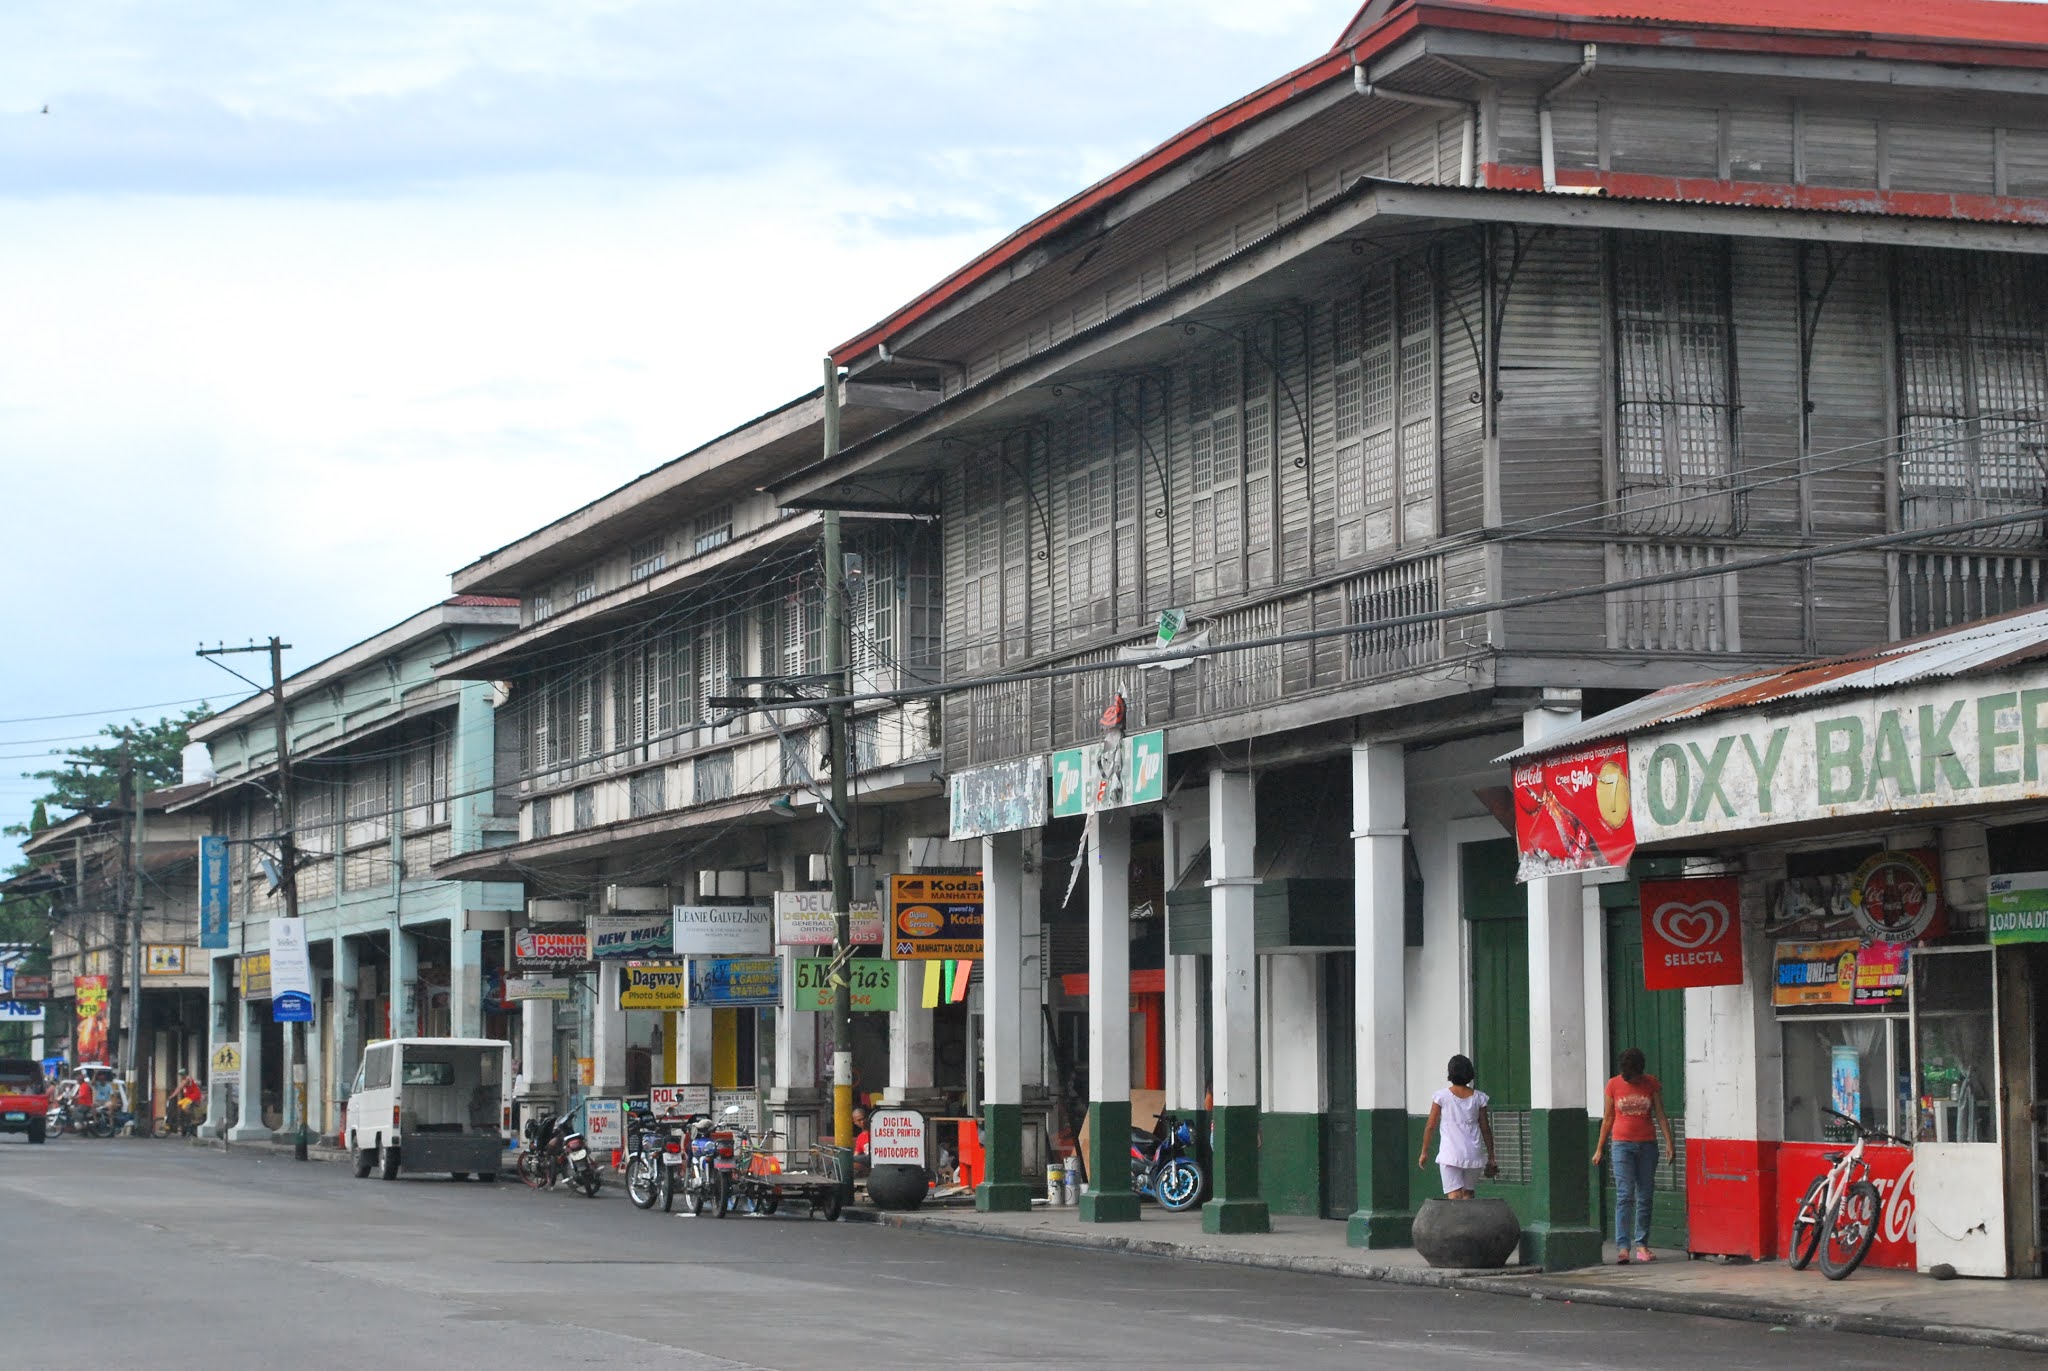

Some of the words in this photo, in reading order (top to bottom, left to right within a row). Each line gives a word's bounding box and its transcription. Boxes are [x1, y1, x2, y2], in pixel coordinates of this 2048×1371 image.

[1647, 726, 1790, 826] OXY
[930, 881, 984, 891] Koda
[800, 895, 817, 911] DE
[677, 908, 707, 923] LEANIE
[709, 908, 768, 923] GALVEZ-JISON
[1990, 912, 2016, 931] LOAD
[2018, 911, 2033, 929] NA
[598, 931, 627, 946] NEW
[631, 925, 666, 941] WAVE
[1866, 925, 1882, 939] OXY
[1885, 928, 1916, 942] BAKERY
[537, 935, 587, 945] DUNKIN
[537, 946, 587, 957] DONUTS
[916, 943, 952, 952] MANHATTAN
[953, 943, 974, 952] COLOR
[1664, 952, 1723, 967] SELECTA
[730, 962, 775, 972] INTERNET
[633, 969, 683, 989] Dagway
[730, 975, 737, 985] &
[740, 974, 776, 985] GAMING
[798, 964, 808, 988] 5
[811, 964, 890, 988] Mria's
[655, 991, 682, 999] Studio
[730, 986, 769, 997] STATION
[818, 989, 872, 1005] Saon
[883, 1117, 912, 1127] DIGITAL
[875, 1128, 894, 1137] LASER
[897, 1128, 921, 1137] PRINTER
[874, 1147, 919, 1158] PHOTOCOPIER
